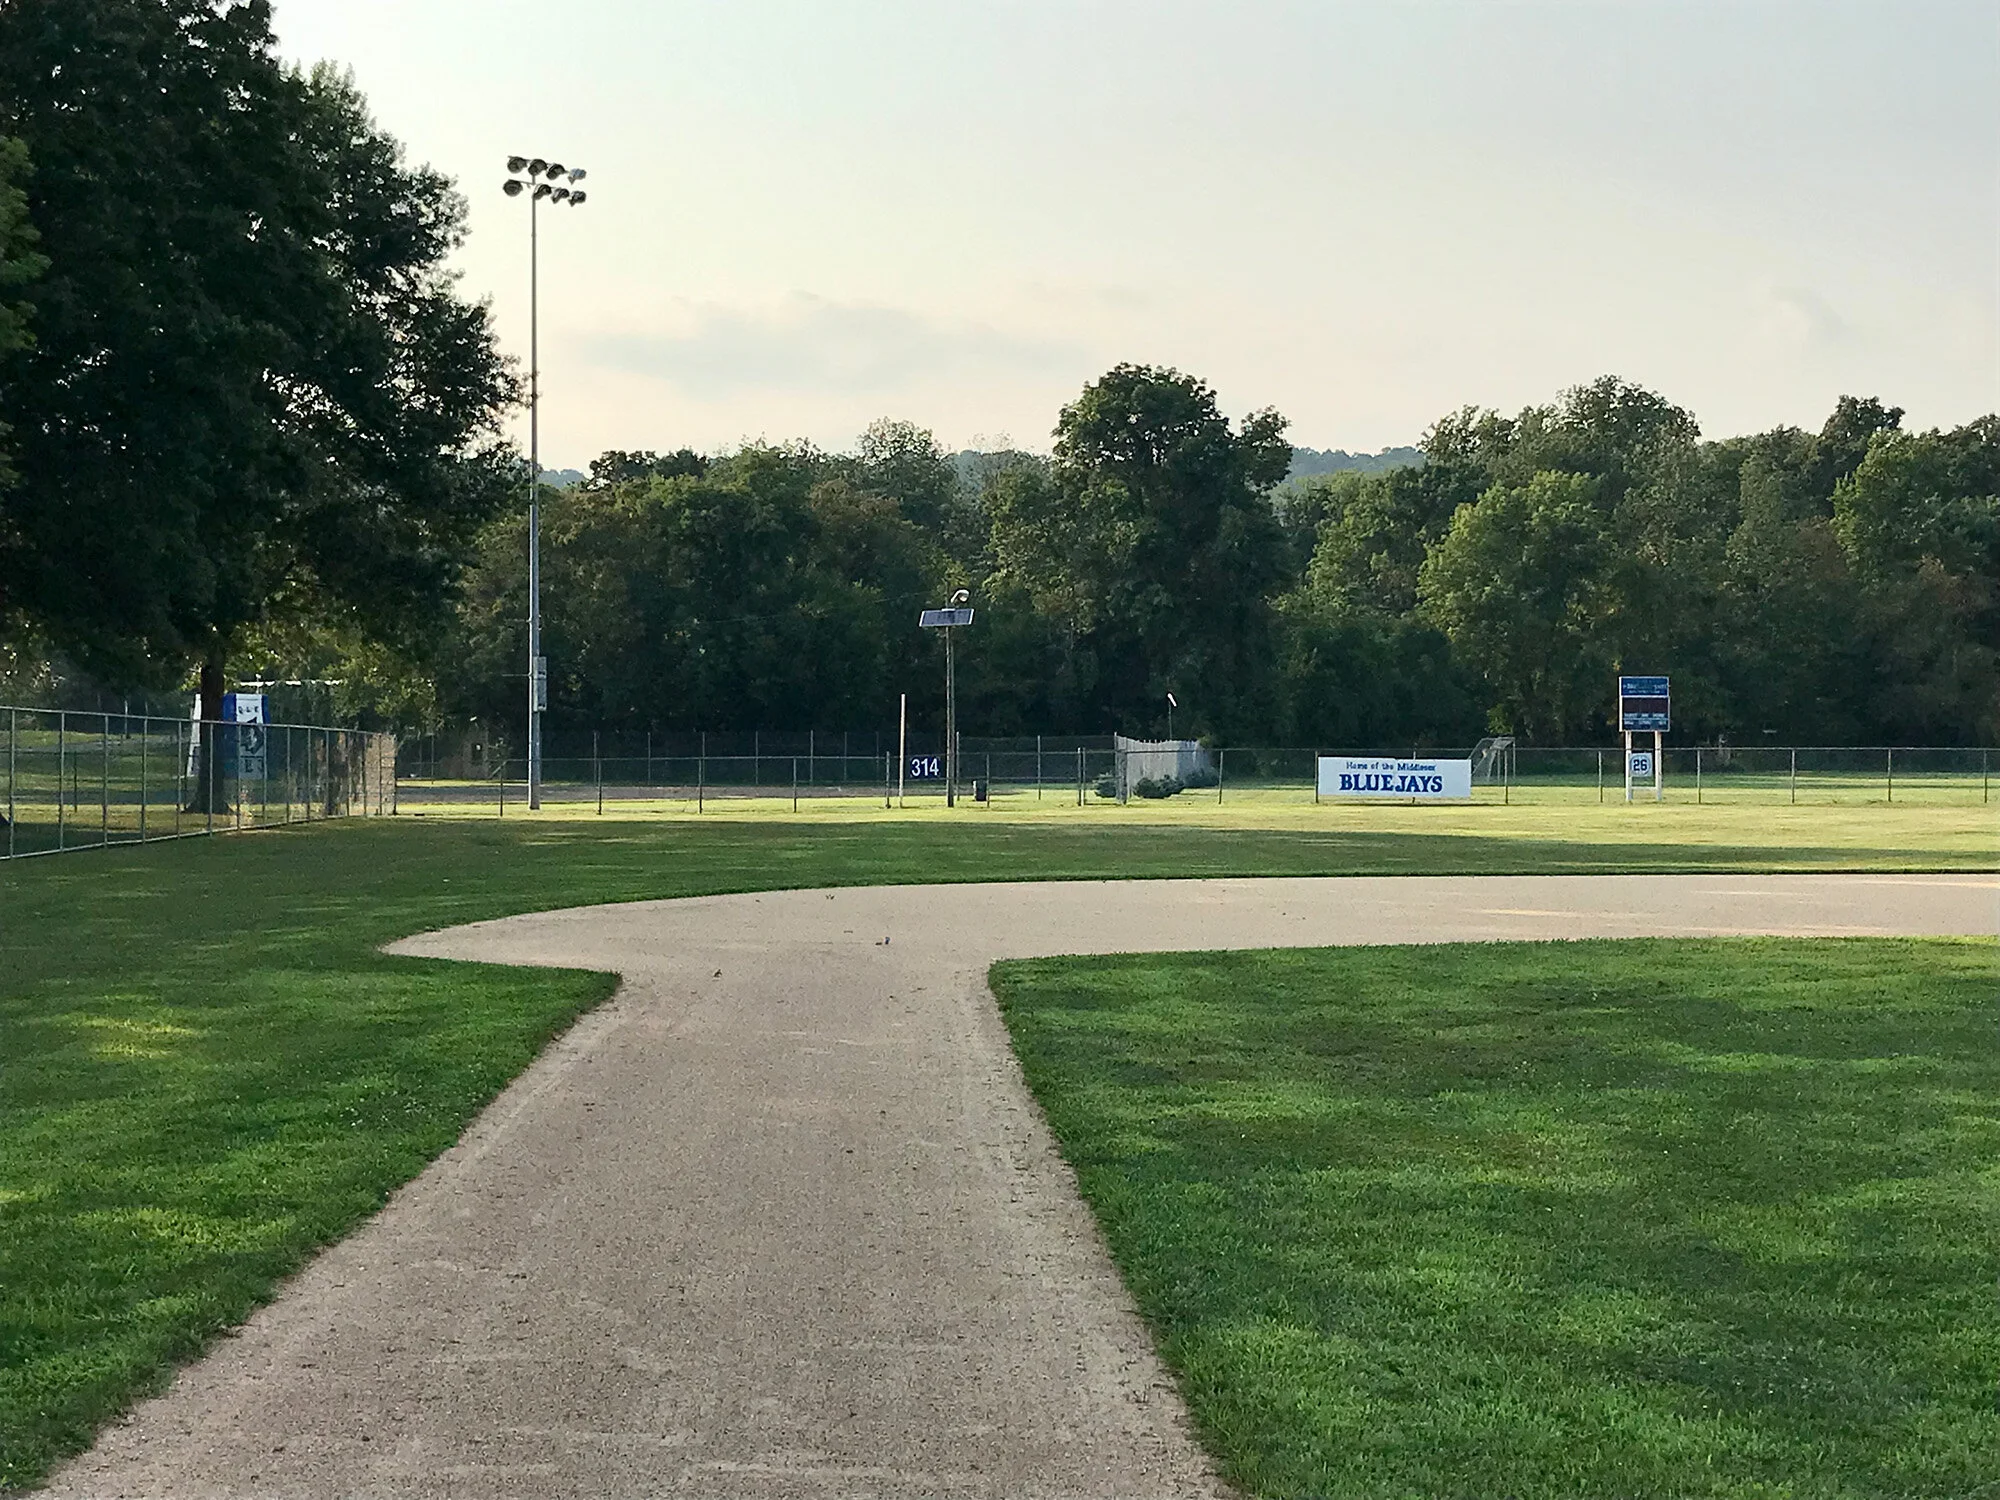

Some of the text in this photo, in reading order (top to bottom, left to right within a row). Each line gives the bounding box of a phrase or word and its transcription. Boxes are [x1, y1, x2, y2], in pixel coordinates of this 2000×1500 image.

[911, 758, 939, 776] 314
[1346, 761, 1368, 770] Home
[1371, 761, 1379, 770] of
[1382, 762, 1394, 770] the
[1633, 759, 1648, 771] 26
